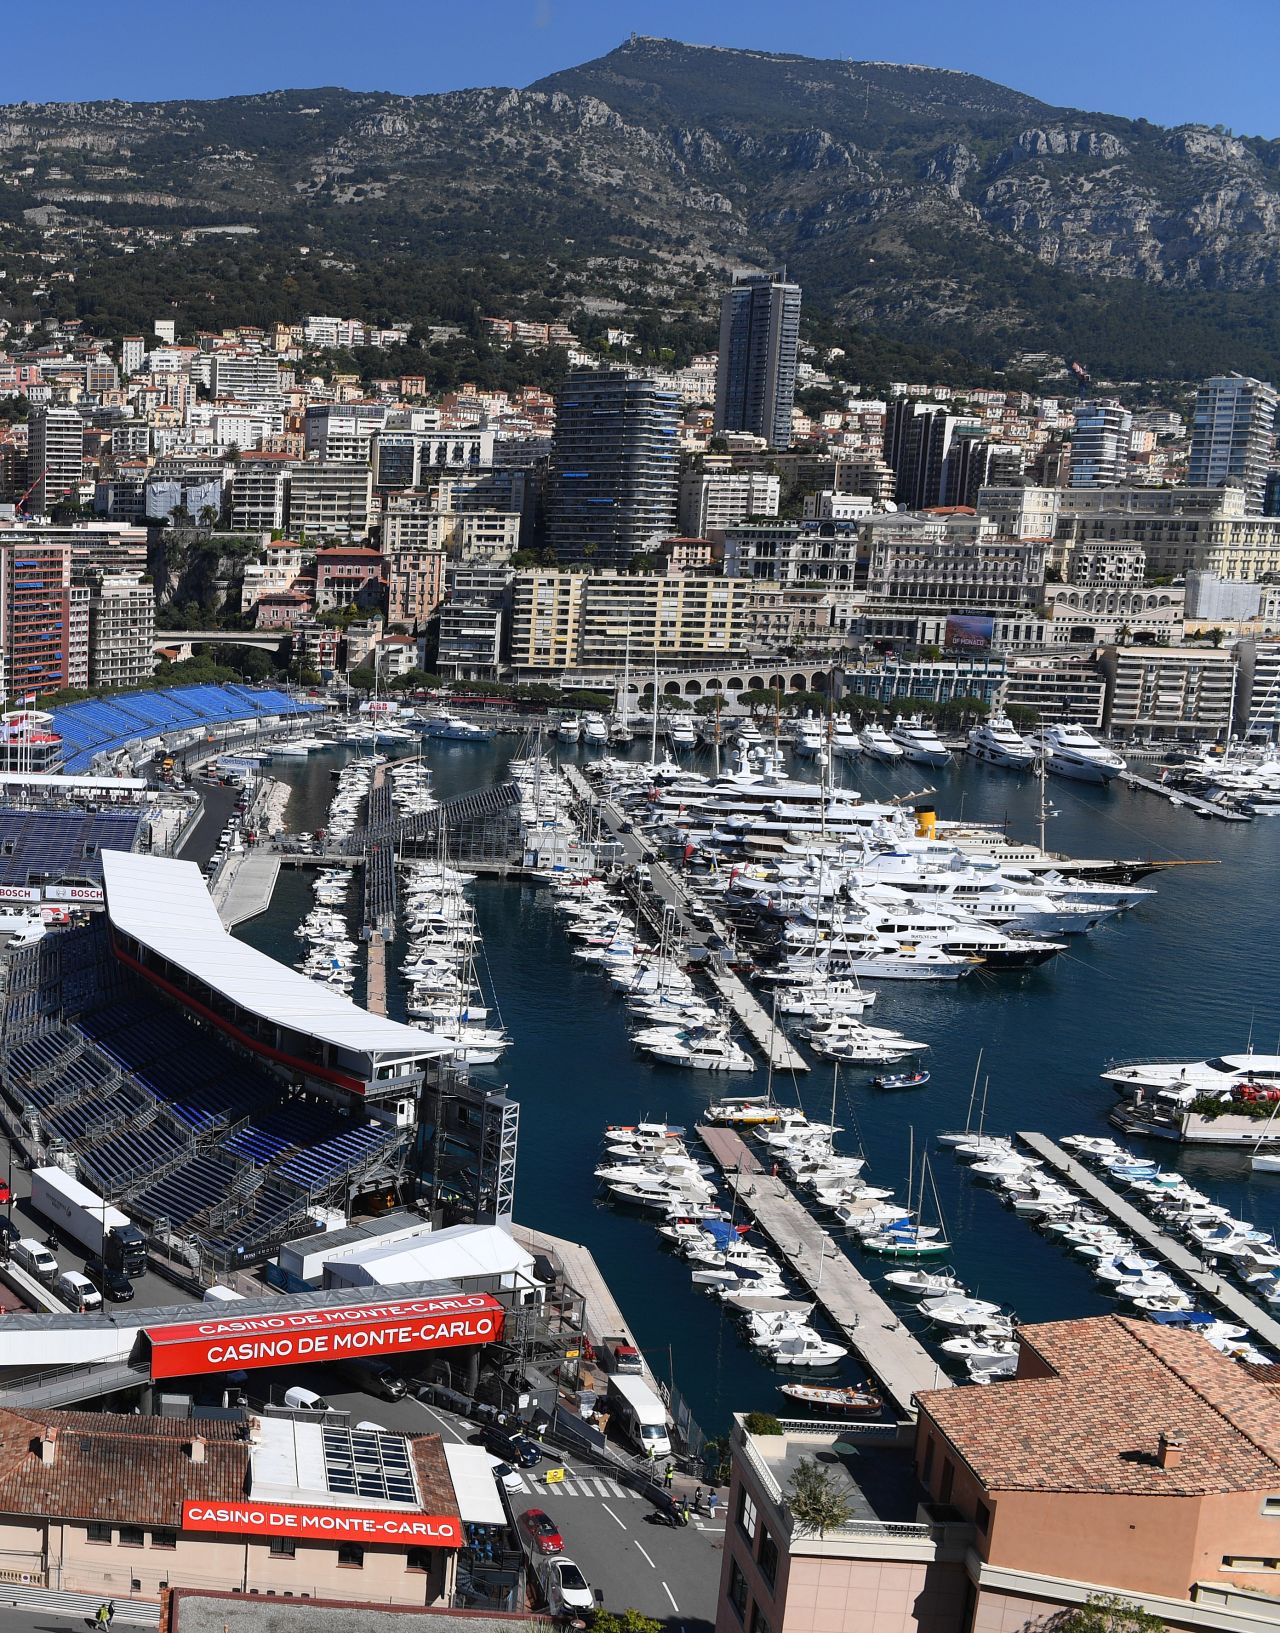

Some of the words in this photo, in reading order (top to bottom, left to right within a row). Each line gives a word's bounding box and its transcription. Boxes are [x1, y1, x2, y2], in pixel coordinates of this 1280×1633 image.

[369, 702, 388, 710] ABB
[0, 888, 31, 898] BOSCH
[70, 889, 103, 898] BOSCH
[258, 1246, 280, 1254] EMOTIO
[198, 1318, 285, 1335] CASINO
[288, 1314, 323, 1325] DE
[324, 1297, 486, 1322] MONTE-CARLO
[207, 1338, 293, 1364] CASINO
[297, 1335, 330, 1355] DE
[333, 1318, 493, 1350] MONTE-CARLO
[188, 1508, 265, 1524] CASINO
[270, 1513, 298, 1527] DE
[302, 1515, 454, 1537] MONTE-CARLO
